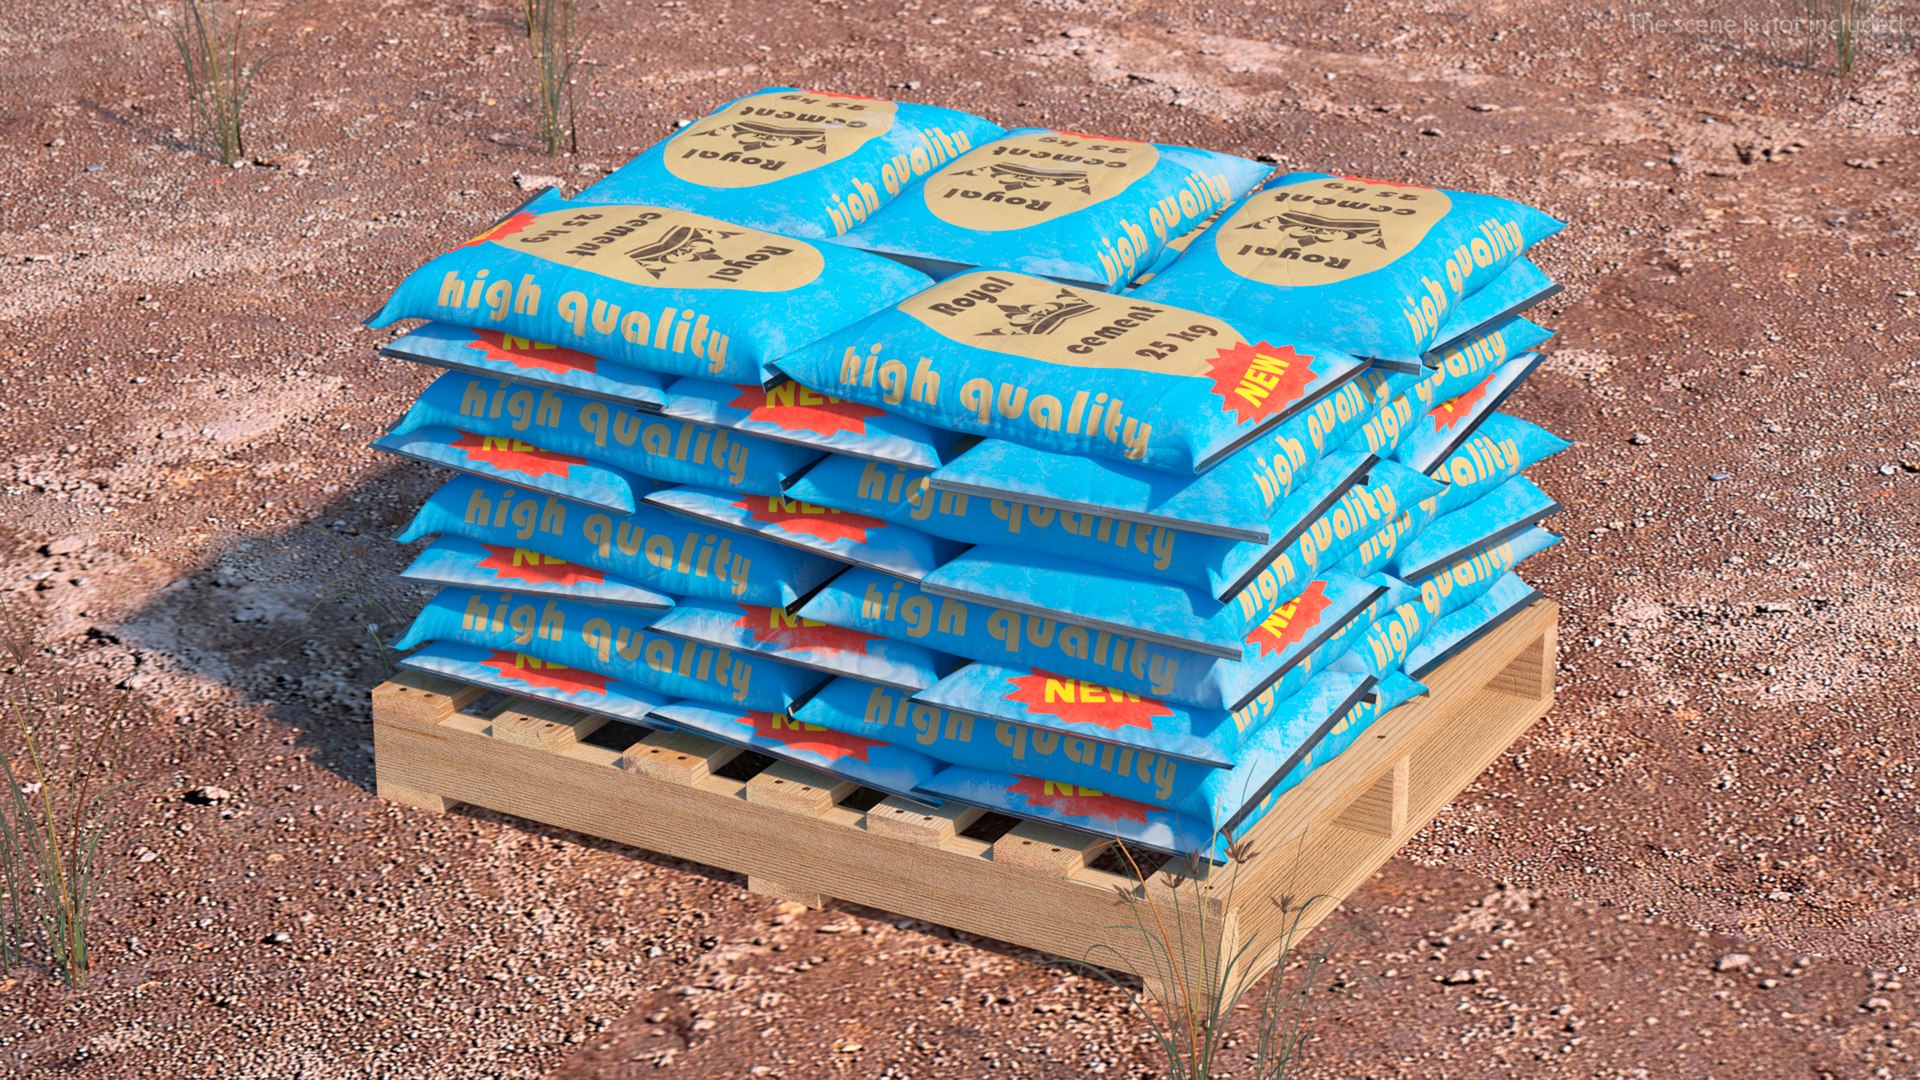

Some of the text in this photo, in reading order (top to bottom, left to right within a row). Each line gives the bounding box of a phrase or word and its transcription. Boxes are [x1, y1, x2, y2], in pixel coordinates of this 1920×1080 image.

[738, 106, 868, 128] cement
[780, 95, 869, 111] 25 kg
[681, 148, 786, 171] Royal
[992, 146, 1128, 169] cement
[1038, 136, 1131, 154] 25 kg
[826, 177, 880, 237] high
[943, 188, 1052, 212] Royal
[1273, 192, 1417, 216] cement
[1323, 182, 1420, 201] 25 kg
[520, 229, 570, 244] kg
[562, 212, 604, 228] 25
[565, 212, 663, 257] cement
[1097, 171, 1232, 286] high quality
[707, 245, 794, 283] Royal
[1237, 244, 1352, 270] Royal
[928, 276, 1015, 317] Royal
[1403, 218, 1523, 345] high quality
[437, 269, 729, 374] high quality
[1066, 305, 1164, 355] cement
[1135, 322, 1219, 361] 25 kg
[766, 380, 852, 408] NE
[839, 342, 1153, 460] high quality
[1234, 353, 1290, 408] NEW
[458, 381, 749, 484] high quality
[1252, 435, 1308, 509] high
[464, 488, 751, 596] high quality
[1300, 484, 1397, 574] quality
[1260, 597, 1301, 638] NE
[1367, 603, 1419, 671] high
[462, 594, 752, 701] high quality
[861, 581, 1179, 696] high quality
